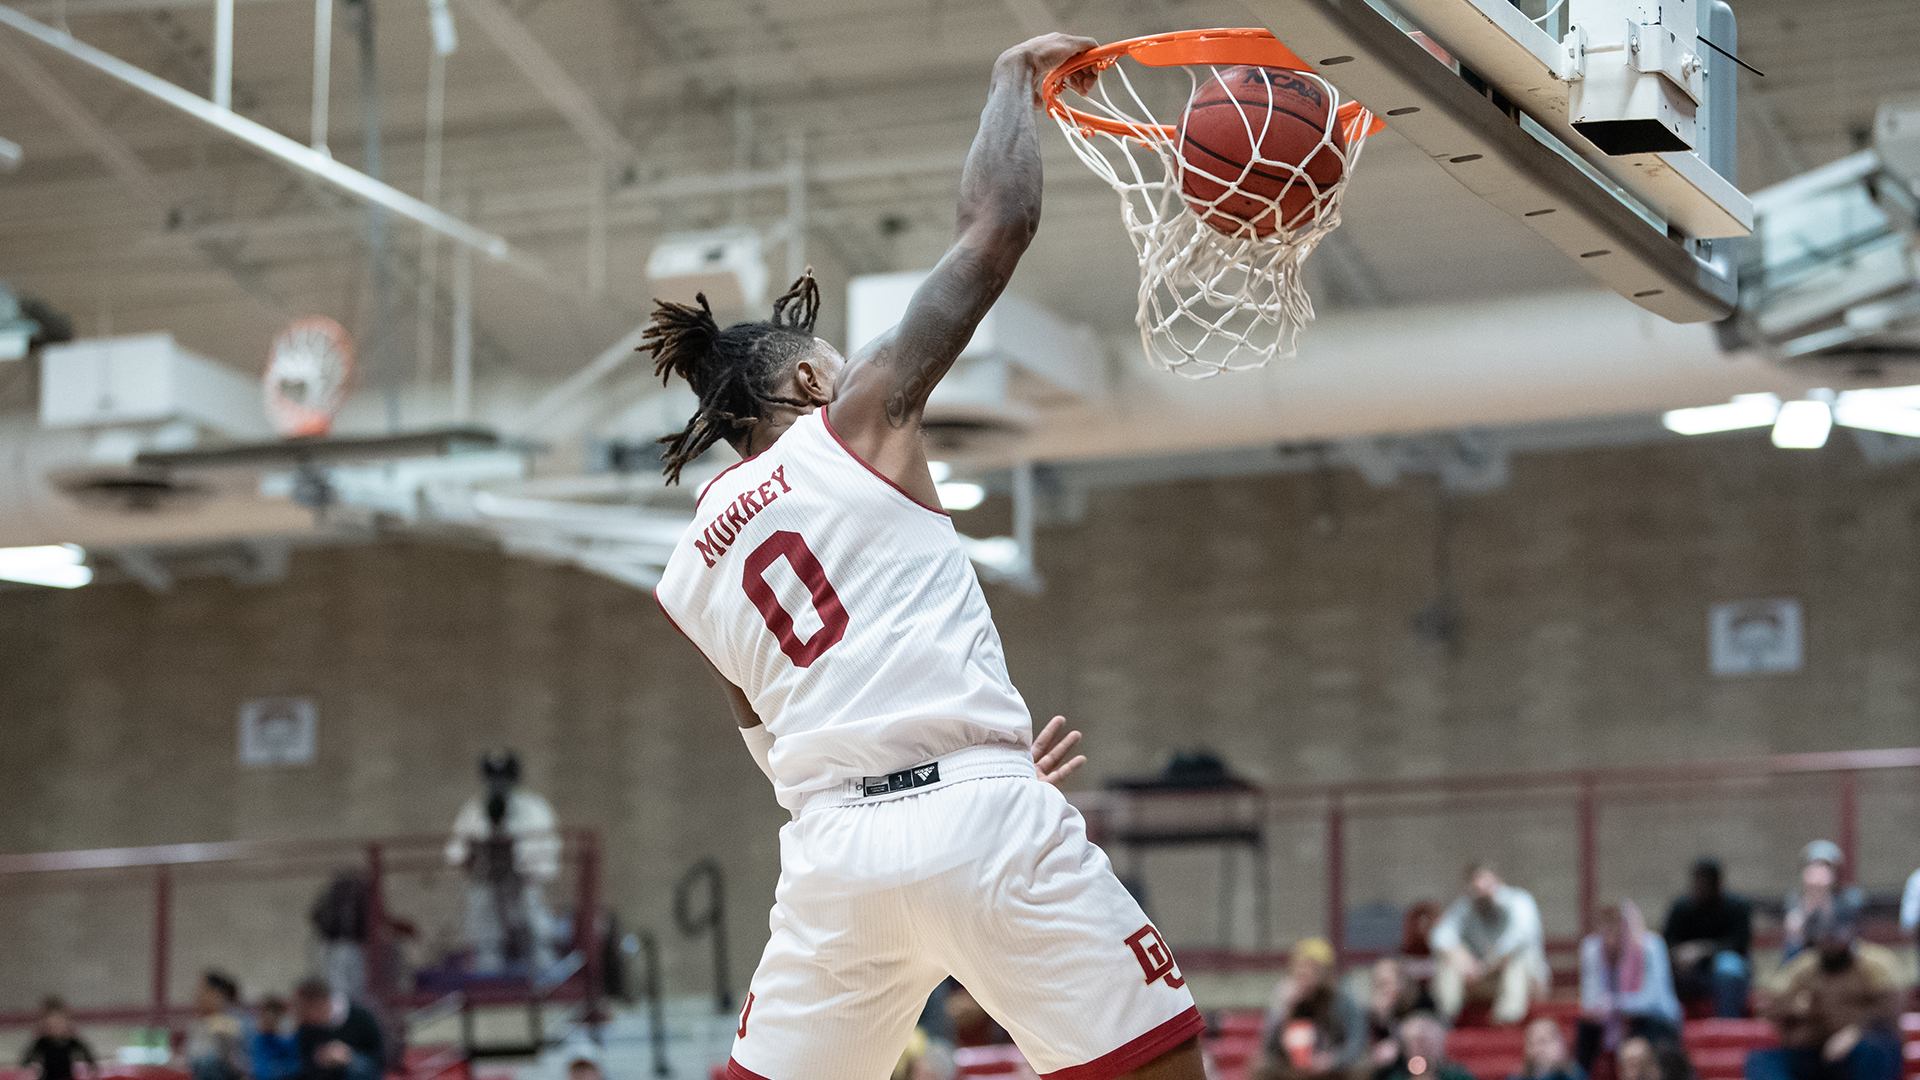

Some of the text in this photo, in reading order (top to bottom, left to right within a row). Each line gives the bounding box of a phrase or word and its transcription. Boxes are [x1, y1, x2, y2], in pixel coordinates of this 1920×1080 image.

[1243, 69, 1321, 108] NCAA
[694, 464, 792, 569] MURKEY
[742, 530, 850, 668] 0
